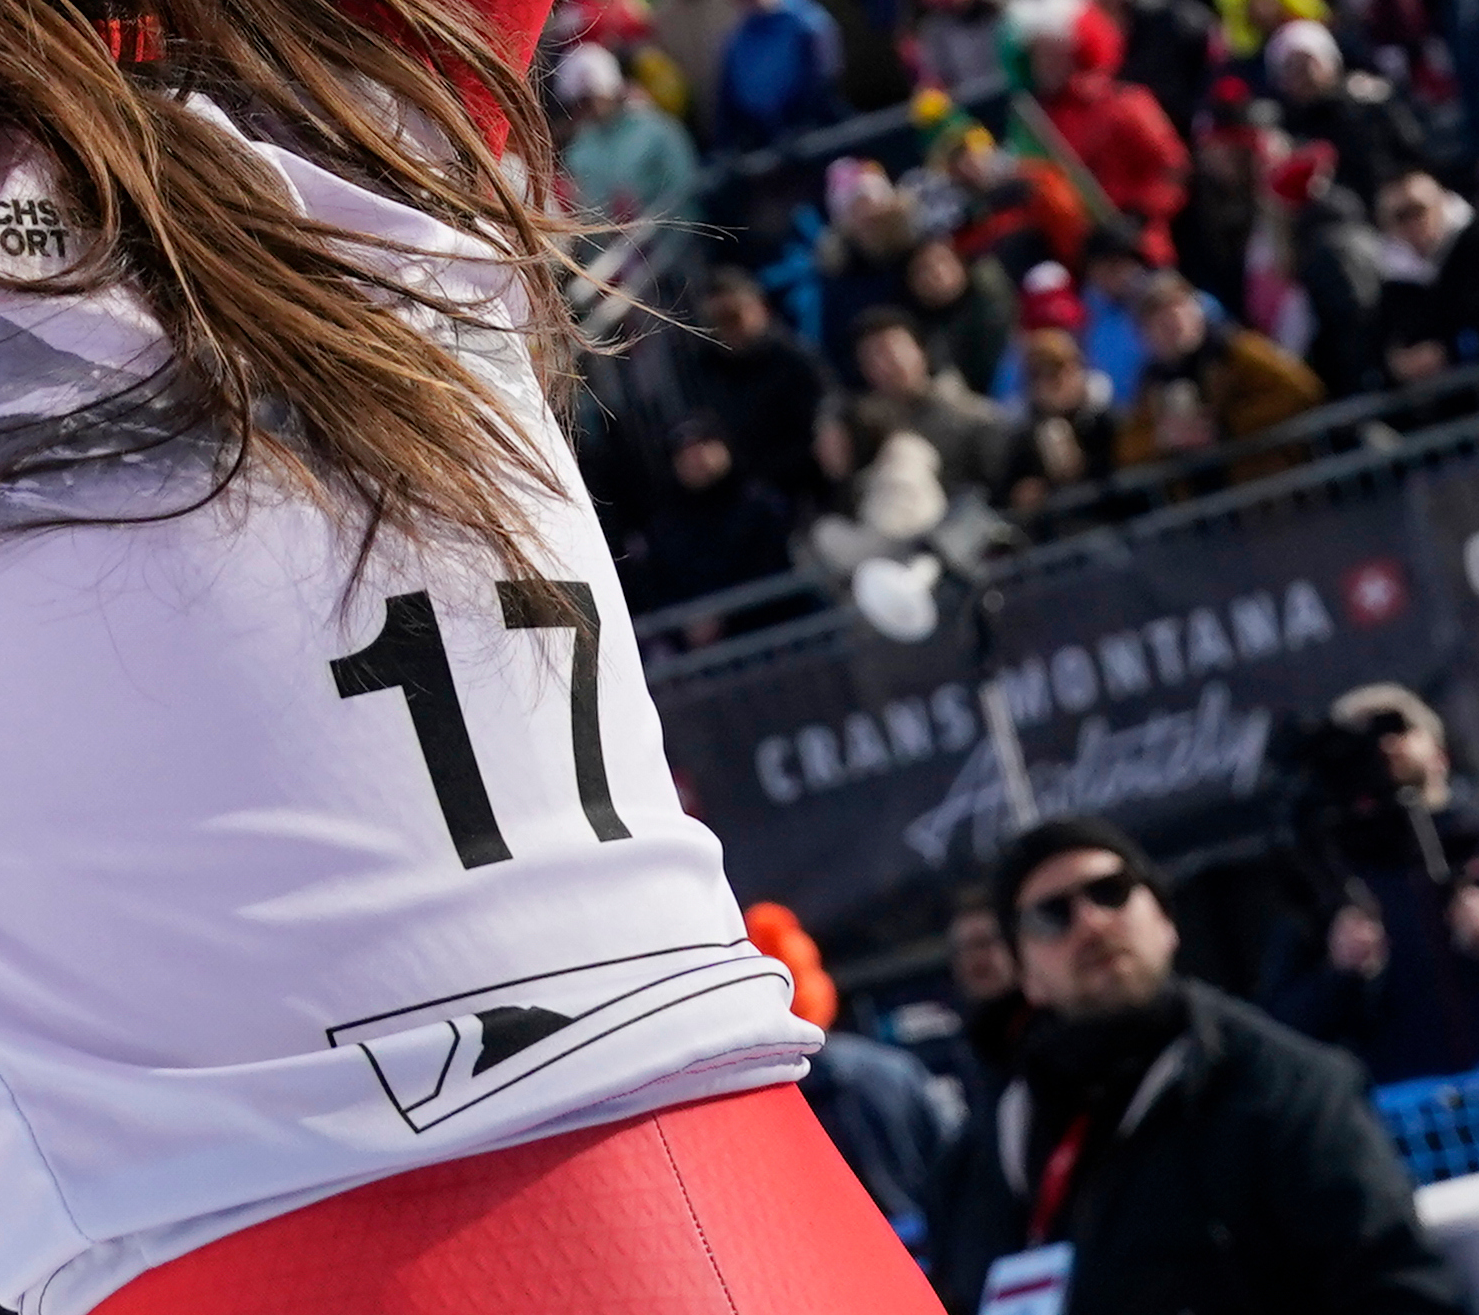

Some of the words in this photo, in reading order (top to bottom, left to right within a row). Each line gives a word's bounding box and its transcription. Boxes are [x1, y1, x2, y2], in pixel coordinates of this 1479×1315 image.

[328, 578, 633, 871] 17
[754, 681, 980, 806] CRANS
[994, 578, 1335, 726] MONTANA
